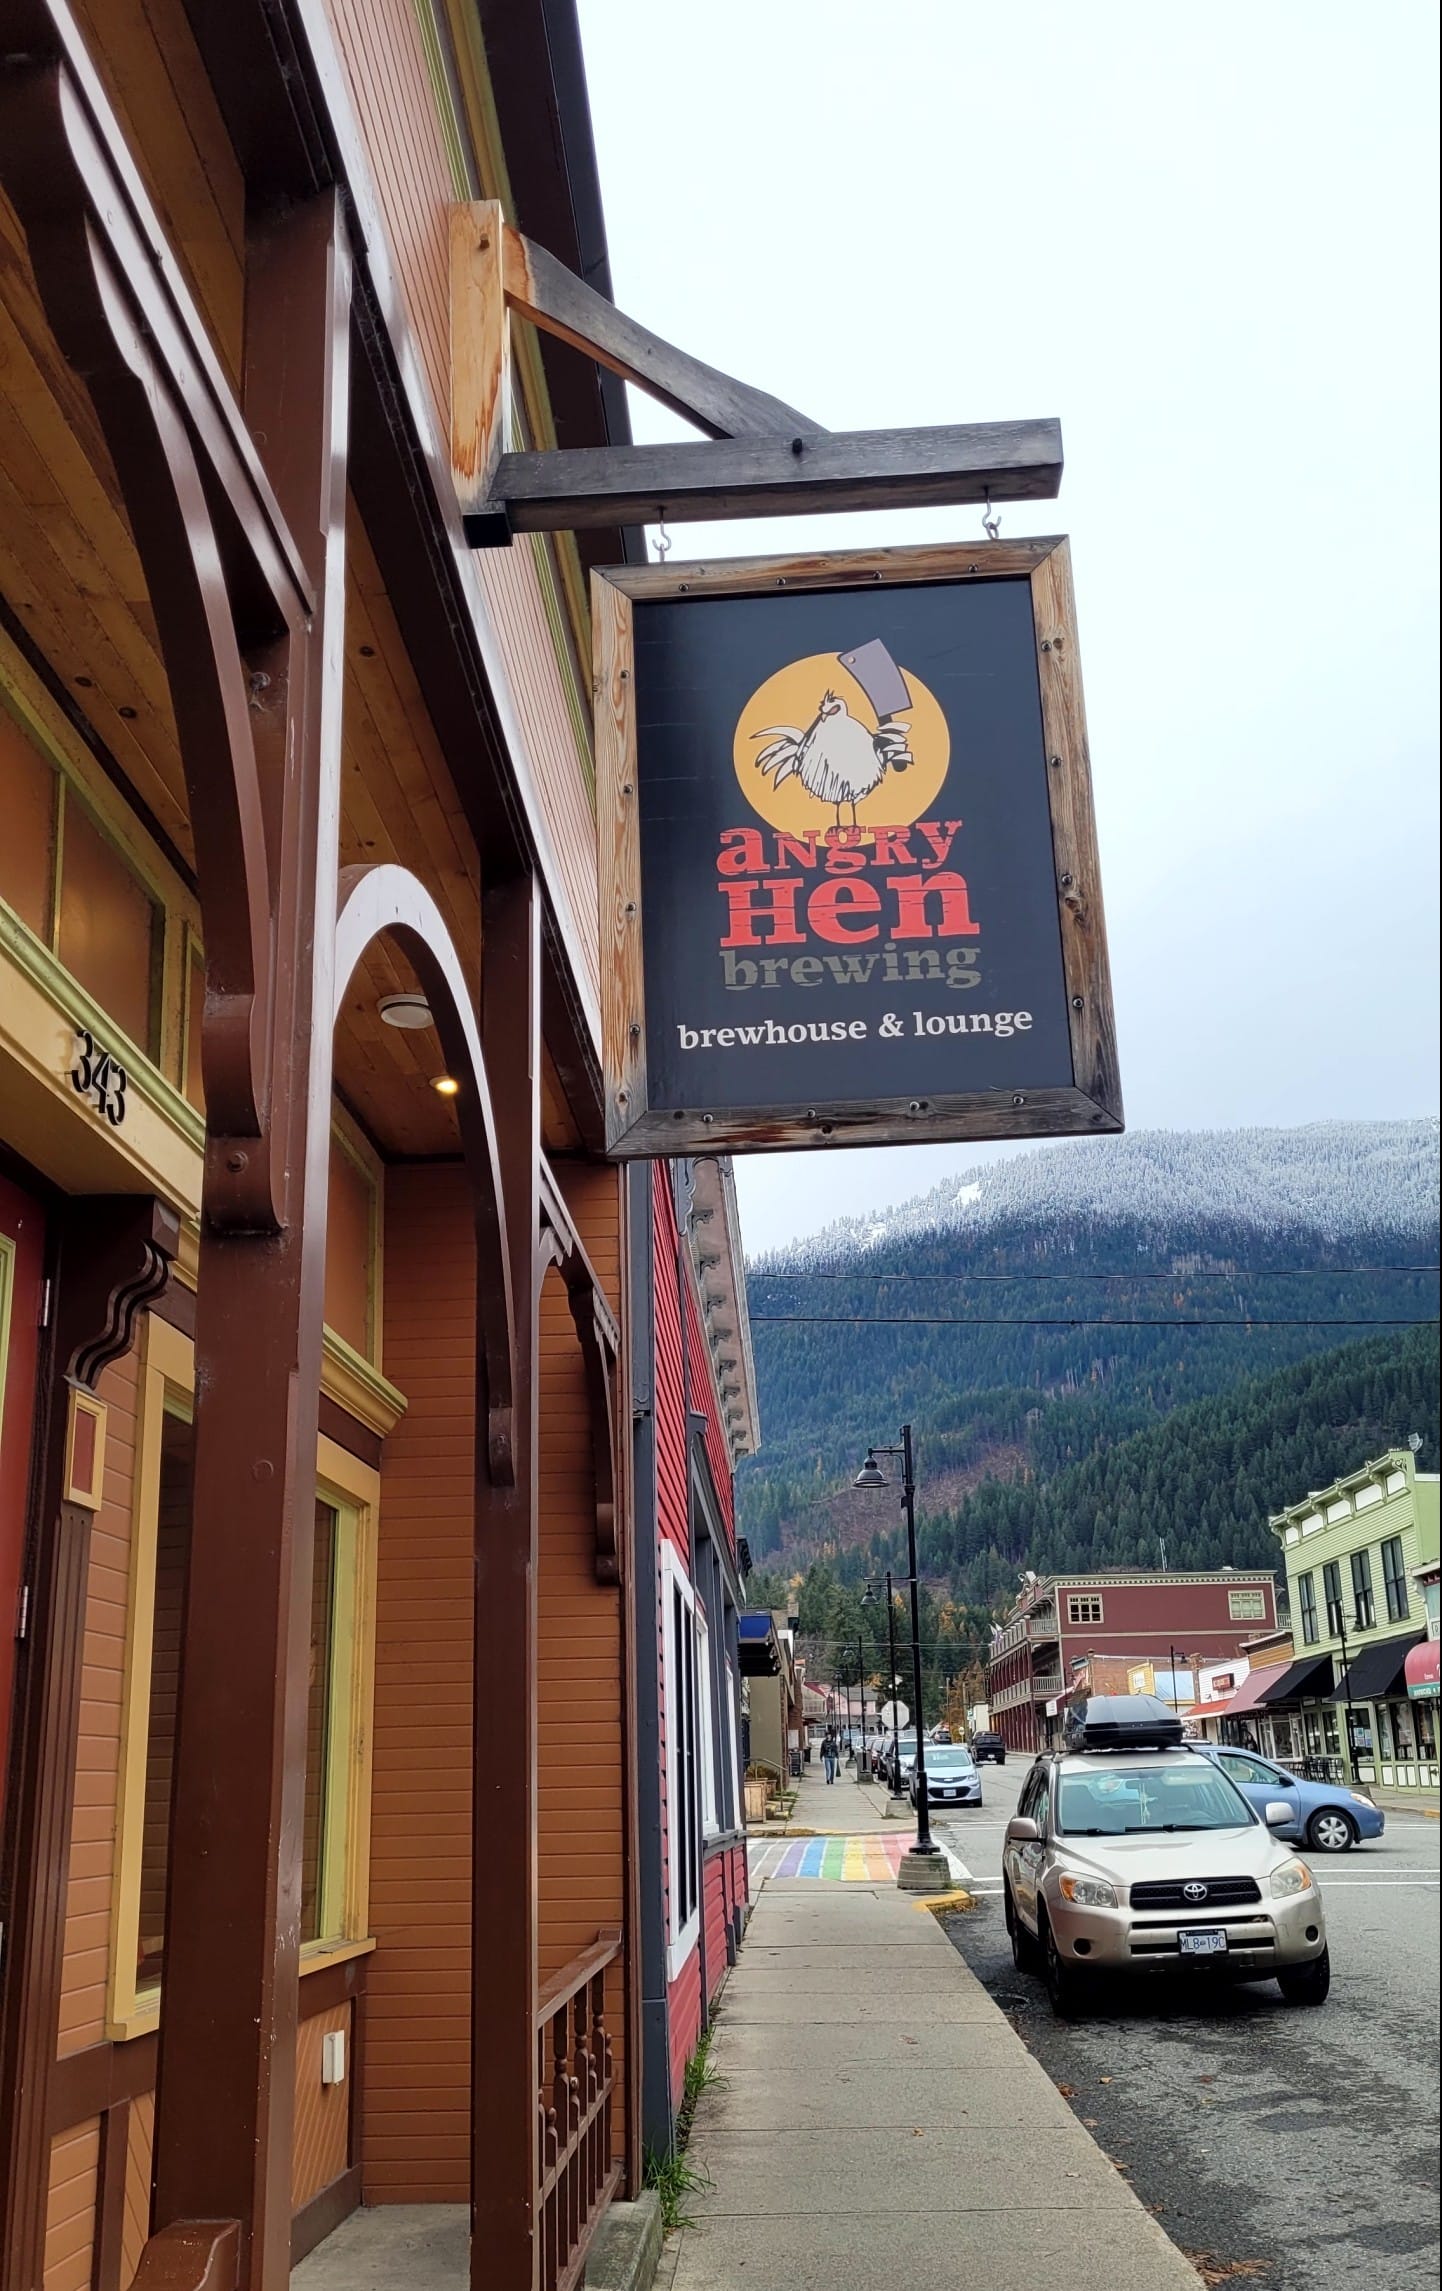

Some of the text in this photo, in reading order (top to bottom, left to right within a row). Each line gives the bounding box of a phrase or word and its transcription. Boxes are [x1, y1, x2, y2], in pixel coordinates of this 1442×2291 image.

[717, 871, 981, 947] Hen
[719, 942, 982, 991] brewing
[677, 1008, 1034, 1050] brewhouse & lounge
[71, 1030, 126, 1126] 343
